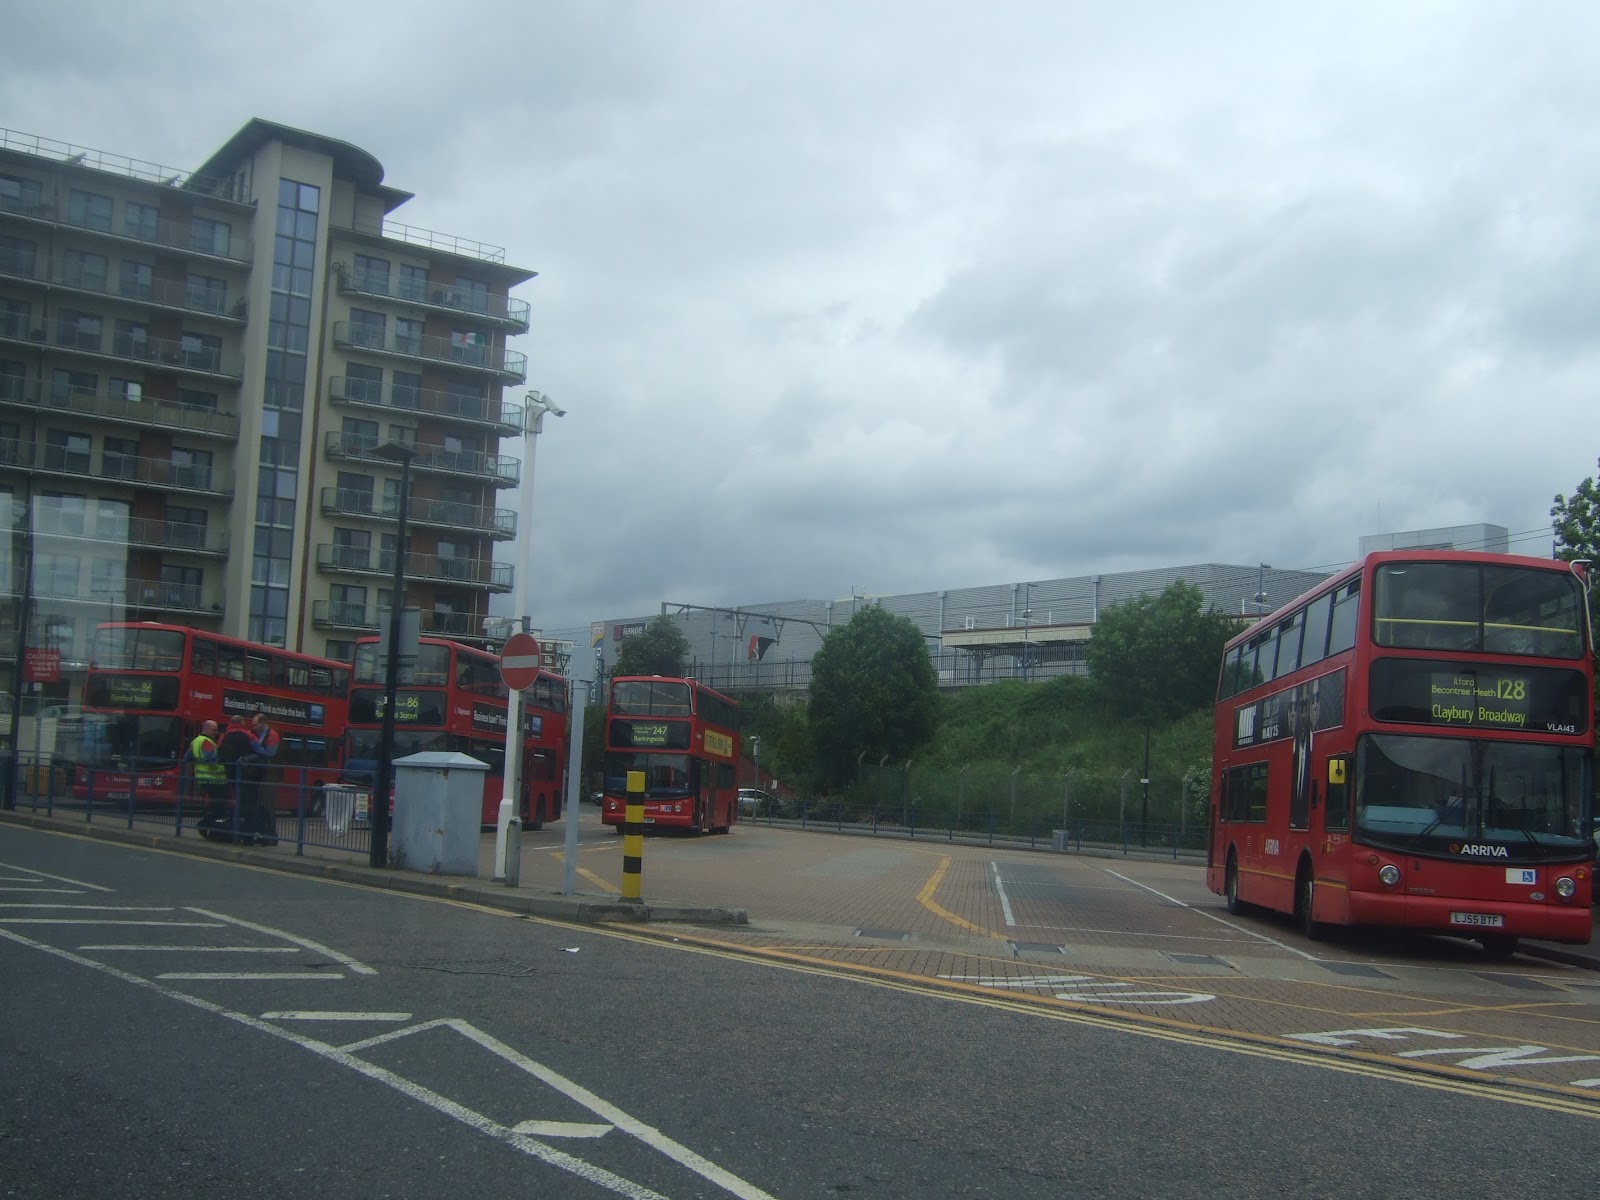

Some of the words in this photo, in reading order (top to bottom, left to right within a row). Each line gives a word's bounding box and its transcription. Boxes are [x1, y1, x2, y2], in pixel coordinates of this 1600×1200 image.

[1453, 677, 1475, 686] Ilford
[141, 682, 153, 693] 86
[1431, 685, 1471, 696] Becontree
[1473, 688, 1496, 697] Heath
[1497, 679, 1526, 700] 128
[224, 697, 246, 710] Business
[259, 702, 272, 713] Think
[406, 697, 419, 707] 86
[474, 709, 489, 723] Business
[1432, 704, 1474, 724] Claybury
[1478, 707, 1526, 726] Broadway
[652, 726, 668, 735] 247
[1547, 723, 1575, 733] VLA143
[633, 735, 665, 743] Barkingside
[1460, 844, 1509, 858] ARRIVA
[1454, 914, 1479, 924] LJ55
[1480, 915, 1499, 925] BTF
